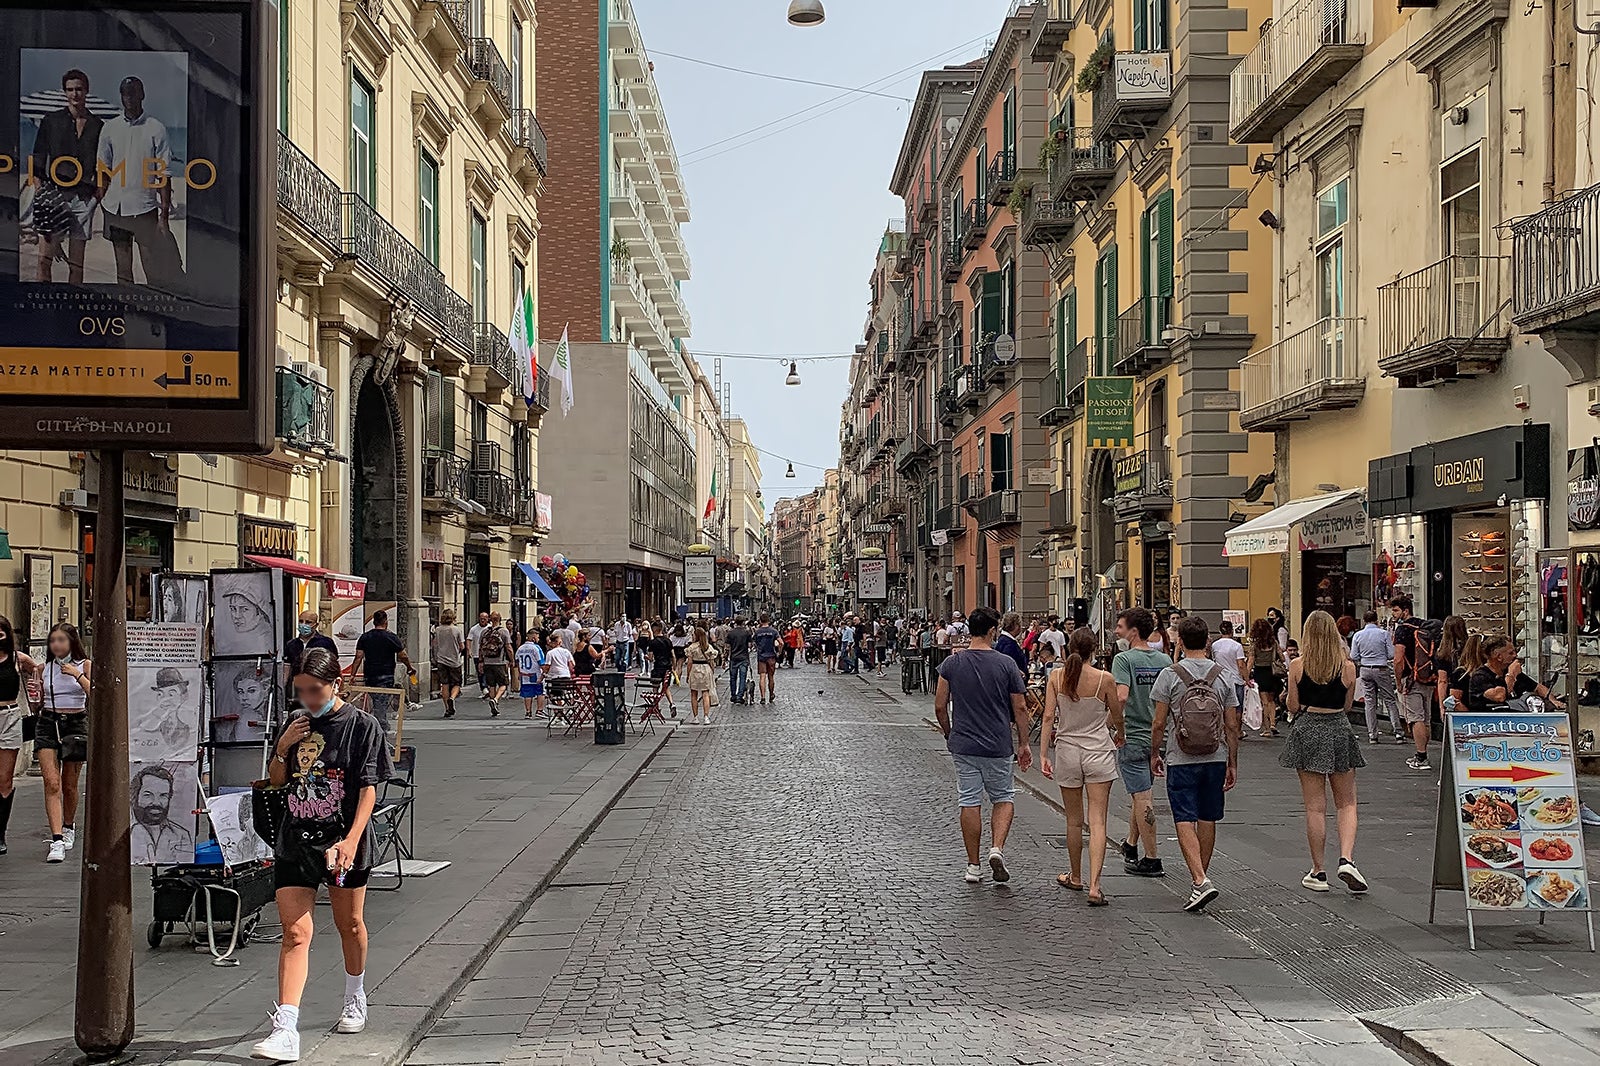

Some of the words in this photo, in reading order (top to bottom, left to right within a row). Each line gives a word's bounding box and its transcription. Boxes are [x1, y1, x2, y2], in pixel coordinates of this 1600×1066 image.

[1127, 57, 1150, 65] Hotel
[1117, 66, 1149, 88] Napoli
[1148, 70, 1169, 90] Mia
[0, 154, 217, 190] PIOMBO
[79, 316, 127, 337] OVS
[49, 365, 146, 378] MATTEOTTI
[195, 373, 212, 387] 50
[1088, 398, 1133, 407] PASSIONE
[1094, 408, 1104, 416] DI
[89, 420, 108, 433] DI
[113, 420, 172, 434] NAPOLI
[1117, 455, 1142, 478] PIZZE
[1434, 457, 1484, 487] URBAN
[248, 524, 298, 551] AUGUSTUS
[520, 654, 532, 670] 10
[1462, 720, 1559, 741] Trattoria
[1463, 740, 1563, 763] Toledo
